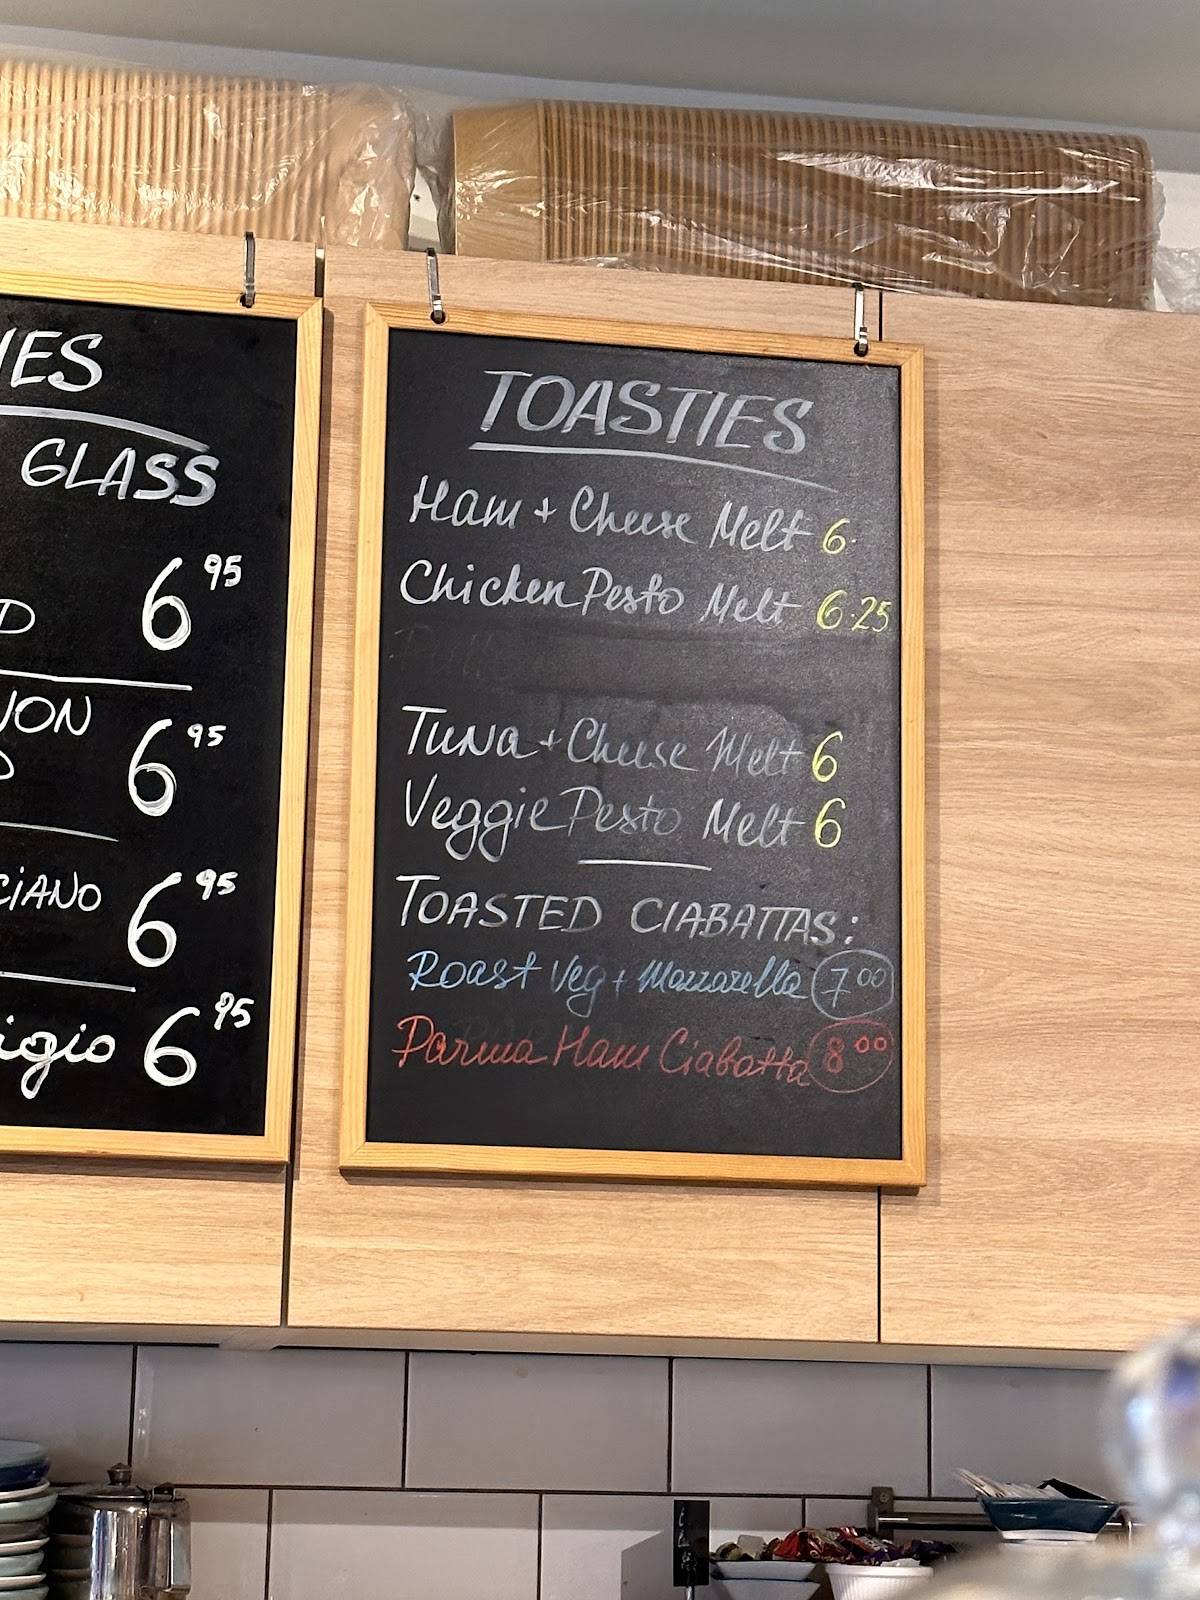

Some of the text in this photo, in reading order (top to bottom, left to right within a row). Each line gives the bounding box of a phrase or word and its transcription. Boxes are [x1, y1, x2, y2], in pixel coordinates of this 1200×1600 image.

[481, 370, 814, 455] TOASTIES
[21, 438, 220, 507] GLASS
[409, 475, 521, 529] Ham
[534, 499, 557, 523] +
[709, 500, 814, 552] Melt
[142, 557, 192, 651] 6
[204, 554, 242, 590] 95
[400, 559, 583, 609] Chicken
[580, 567, 684, 616] Pesto
[701, 583, 802, 625] Melt
[128, 719, 177, 817] 6
[187, 723, 228, 748] 95
[539, 730, 560, 752] +
[705, 727, 803, 778] Melt
[811, 731, 844, 783] 6
[405, 774, 847, 863] Veggie Pesto Melt 6
[128, 872, 182, 968] 6
[196, 868, 239, 900] 95
[396, 874, 860, 945] TOASTED CIABATTAS:
[408, 950, 543, 992] Roast
[551, 960, 602, 1018] Veg
[612, 969, 626, 993] +
[144, 1007, 200, 1087] 6
[214, 992, 255, 1031] 95
[392, 1014, 548, 1081] Parma
[553, 1024, 653, 1073] Ham
[659, 1027, 811, 1087] Ciabatta
